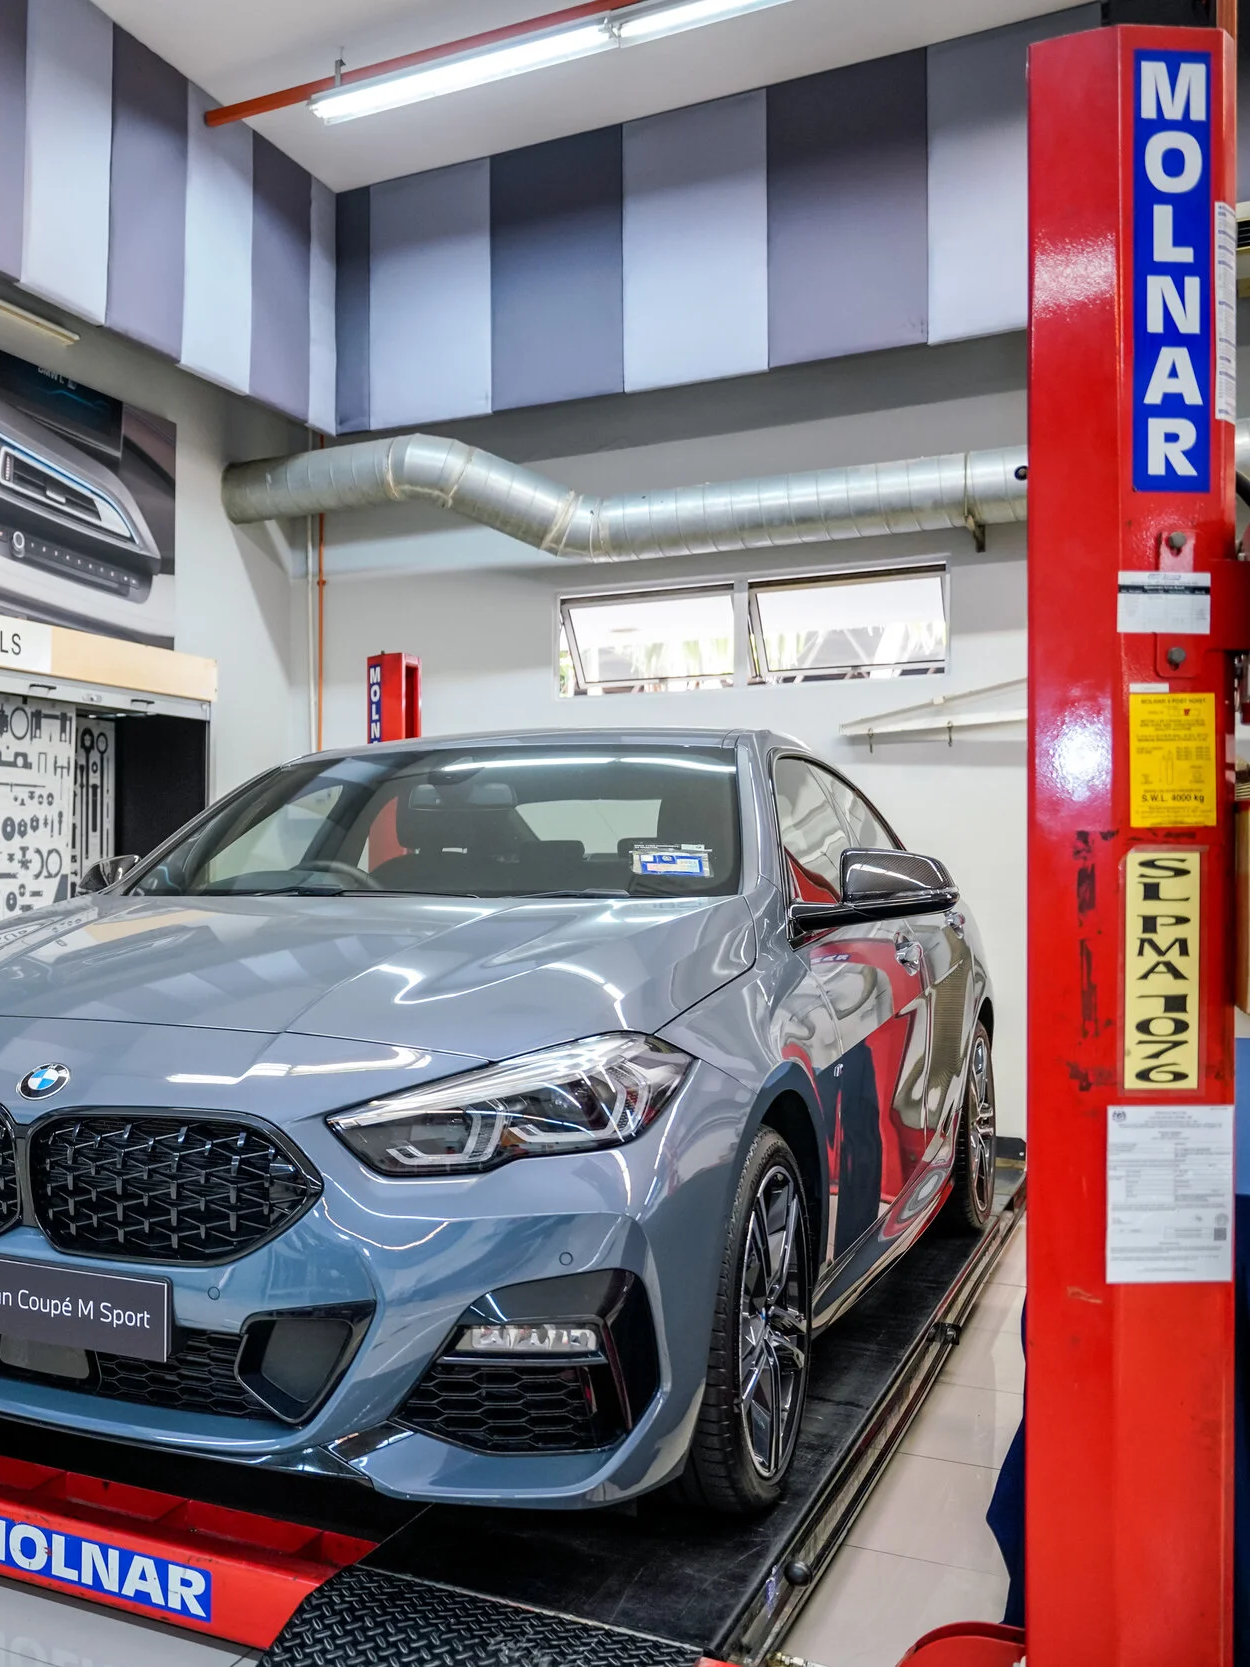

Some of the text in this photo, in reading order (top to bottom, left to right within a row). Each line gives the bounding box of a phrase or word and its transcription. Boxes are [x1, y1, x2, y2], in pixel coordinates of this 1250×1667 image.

[1140, 60, 1207, 477] MOLNAR
[370, 666, 381, 743] MOLN
[1193, 794, 1205, 803] kg
[17, 1289, 73, 1318] Coupé
[78, 1299, 94, 1320] M
[99, 1302, 151, 1329] Sport
